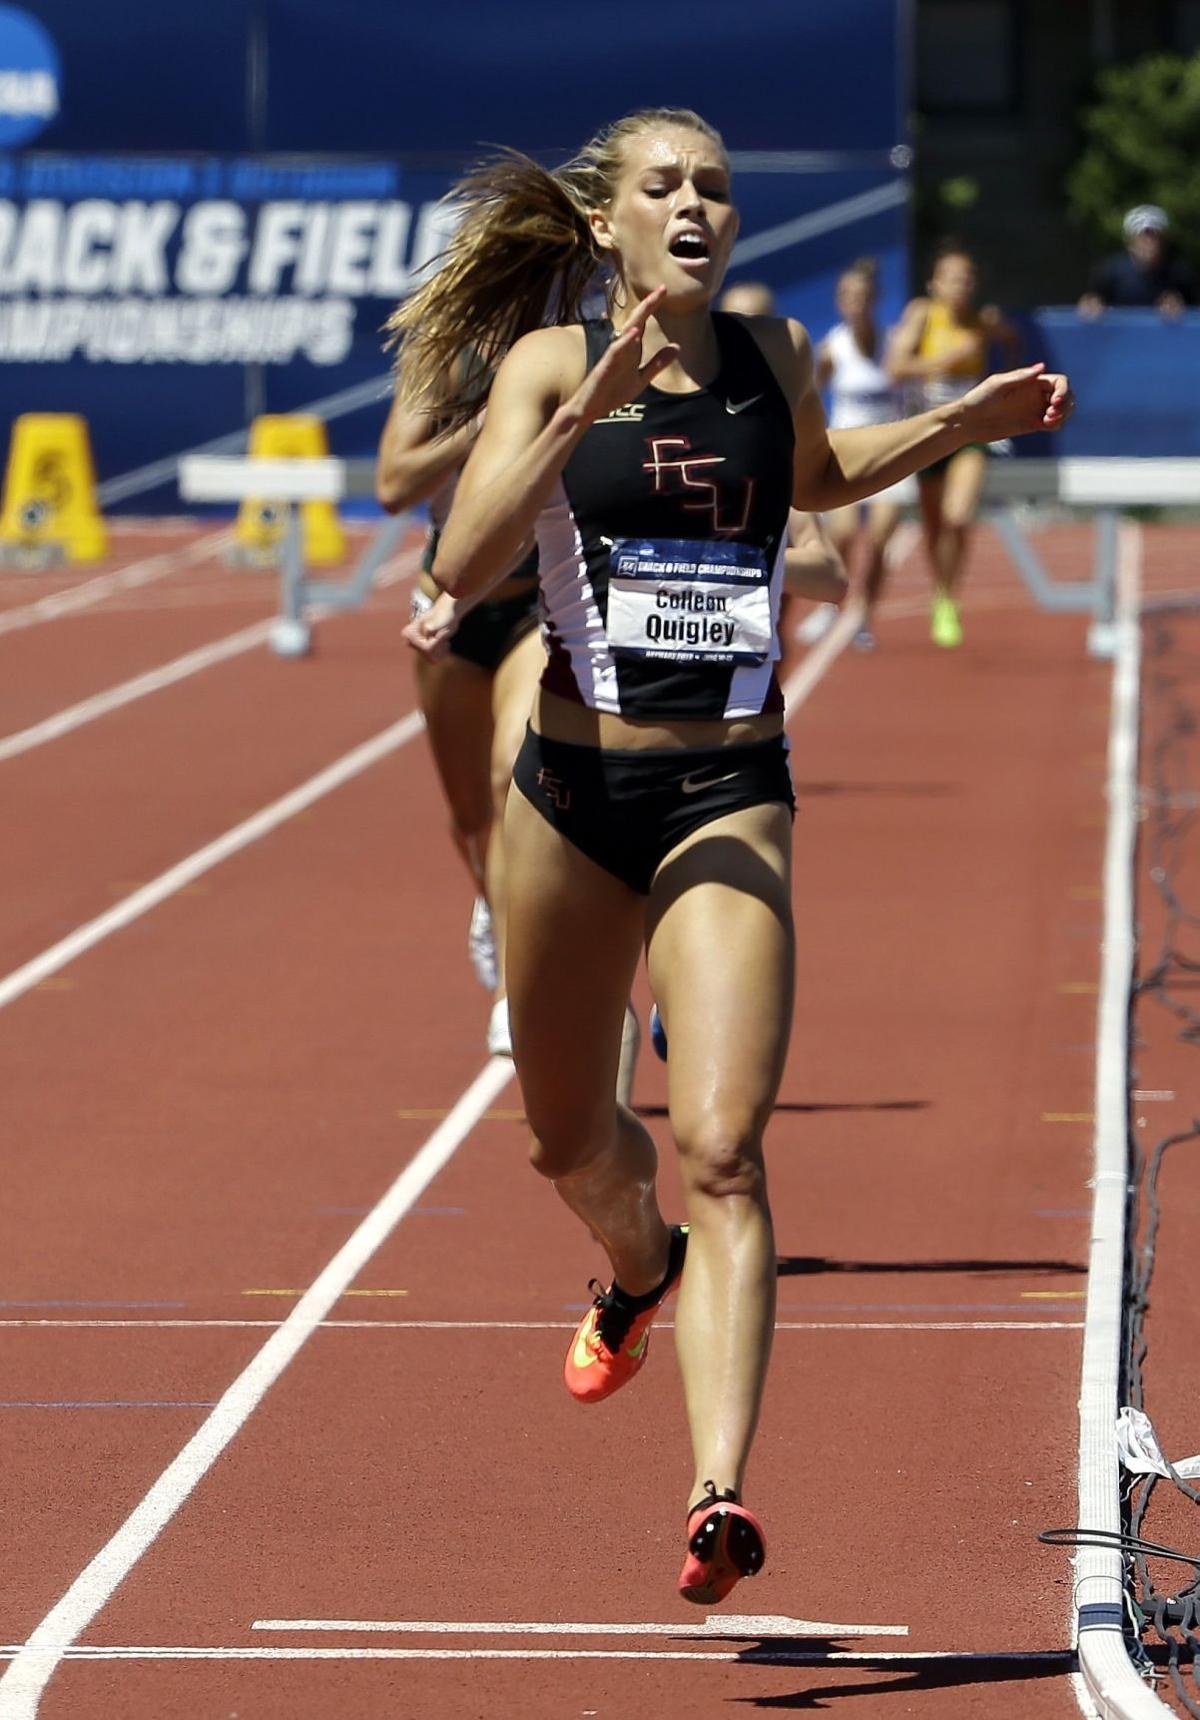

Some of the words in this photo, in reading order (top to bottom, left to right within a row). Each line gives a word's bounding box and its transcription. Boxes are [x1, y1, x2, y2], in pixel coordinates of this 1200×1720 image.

[174, 199, 248, 295] &
[643, 436, 754, 533] FSU
[673, 563, 697, 574] FIELD
[697, 564, 762, 578] CHAMPIONSHIPS
[656, 590, 726, 612] Colleen
[646, 614, 735, 646] Quigley
